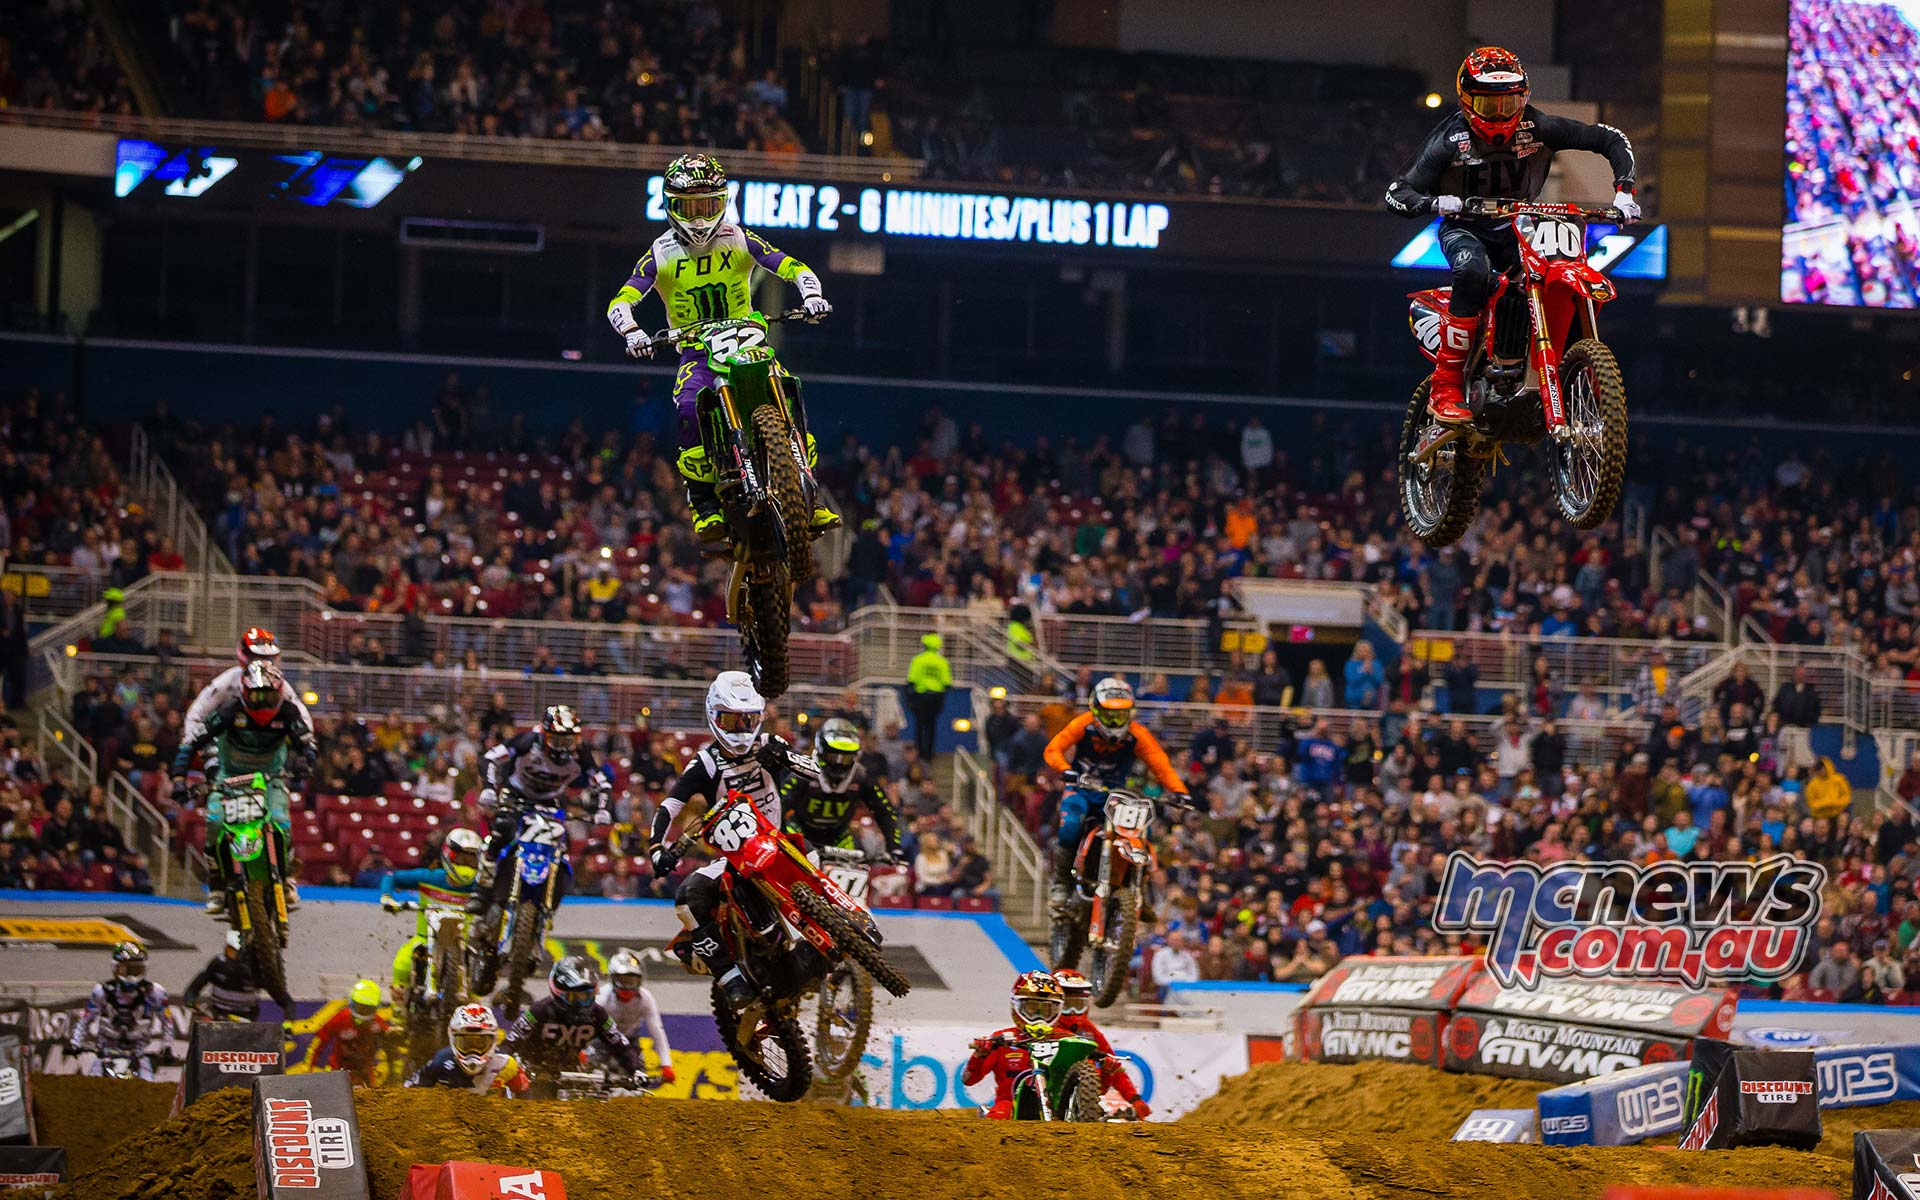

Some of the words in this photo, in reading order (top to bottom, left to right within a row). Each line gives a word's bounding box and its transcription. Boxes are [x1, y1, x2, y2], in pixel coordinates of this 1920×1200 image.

[743, 181, 815, 229] HEAT
[816, 186, 840, 231] 2
[859, 188, 882, 233] 6
[1094, 201, 1109, 246] 1
[1111, 202, 1170, 249] LAP
[1531, 221, 1581, 258] 40
[675, 250, 732, 279] FOX
[710, 327, 766, 364] 52
[808, 798, 850, 818] FLY
[1112, 801, 1149, 829] 181
[709, 802, 759, 853] 83
[202, 1051, 279, 1065] DISCOUNT
[223, 1063, 257, 1072] TIRE
[1740, 1080, 1813, 1095] DISCOUNT
[1761, 1093, 1794, 1102] TIRE
[1617, 1075, 1684, 1136] WPS
[1541, 1114, 1590, 1135] WPS
[265, 1098, 322, 1188] DISCOUNT
[318, 1125, 346, 1164] TIRE
